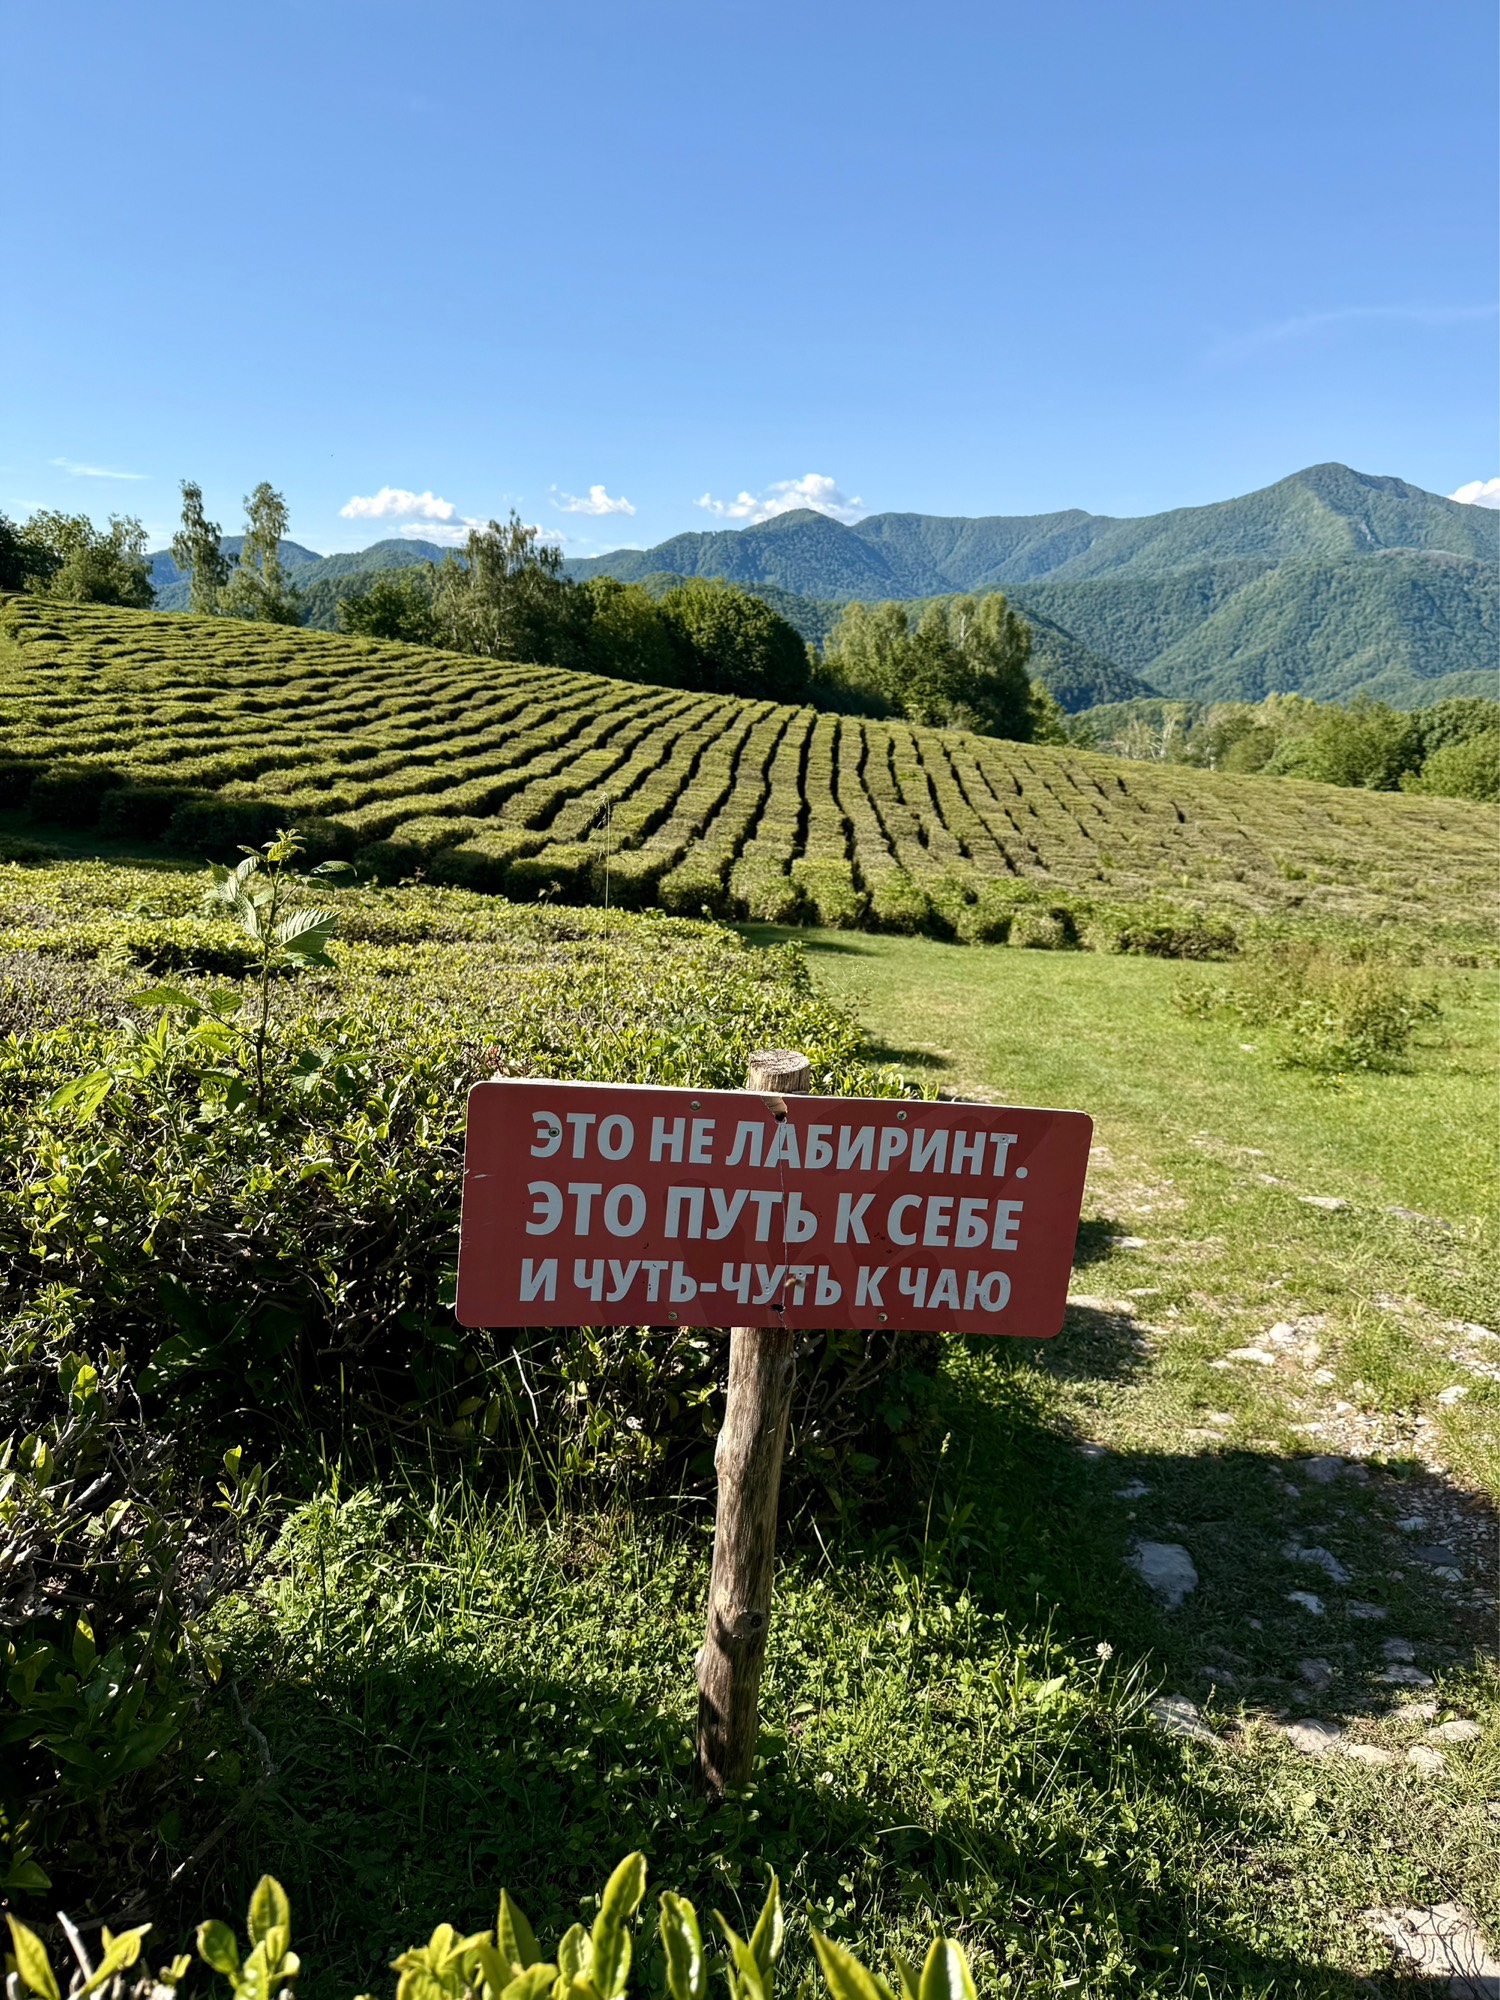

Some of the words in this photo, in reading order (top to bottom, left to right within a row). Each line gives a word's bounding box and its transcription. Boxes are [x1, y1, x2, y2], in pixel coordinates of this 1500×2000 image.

[530, 1111, 634, 1161] ЭТО
[649, 1116, 716, 1164] НЕ
[726, 1120, 1028, 1179] ЛАБИРИНТ.
[525, 1181, 647, 1237] ЭТО
[664, 1186, 818, 1243] ПУТЬ
[834, 1193, 876, 1244] К
[887, 1194, 1024, 1251] СЕБЕ
[519, 1258, 558, 1302] И
[573, 1259, 842, 1307] ЧУТЬ-ЧУТЬ
[855, 1266, 889, 1307] К
[898, 1267, 1011, 1312] ЧАЮ
